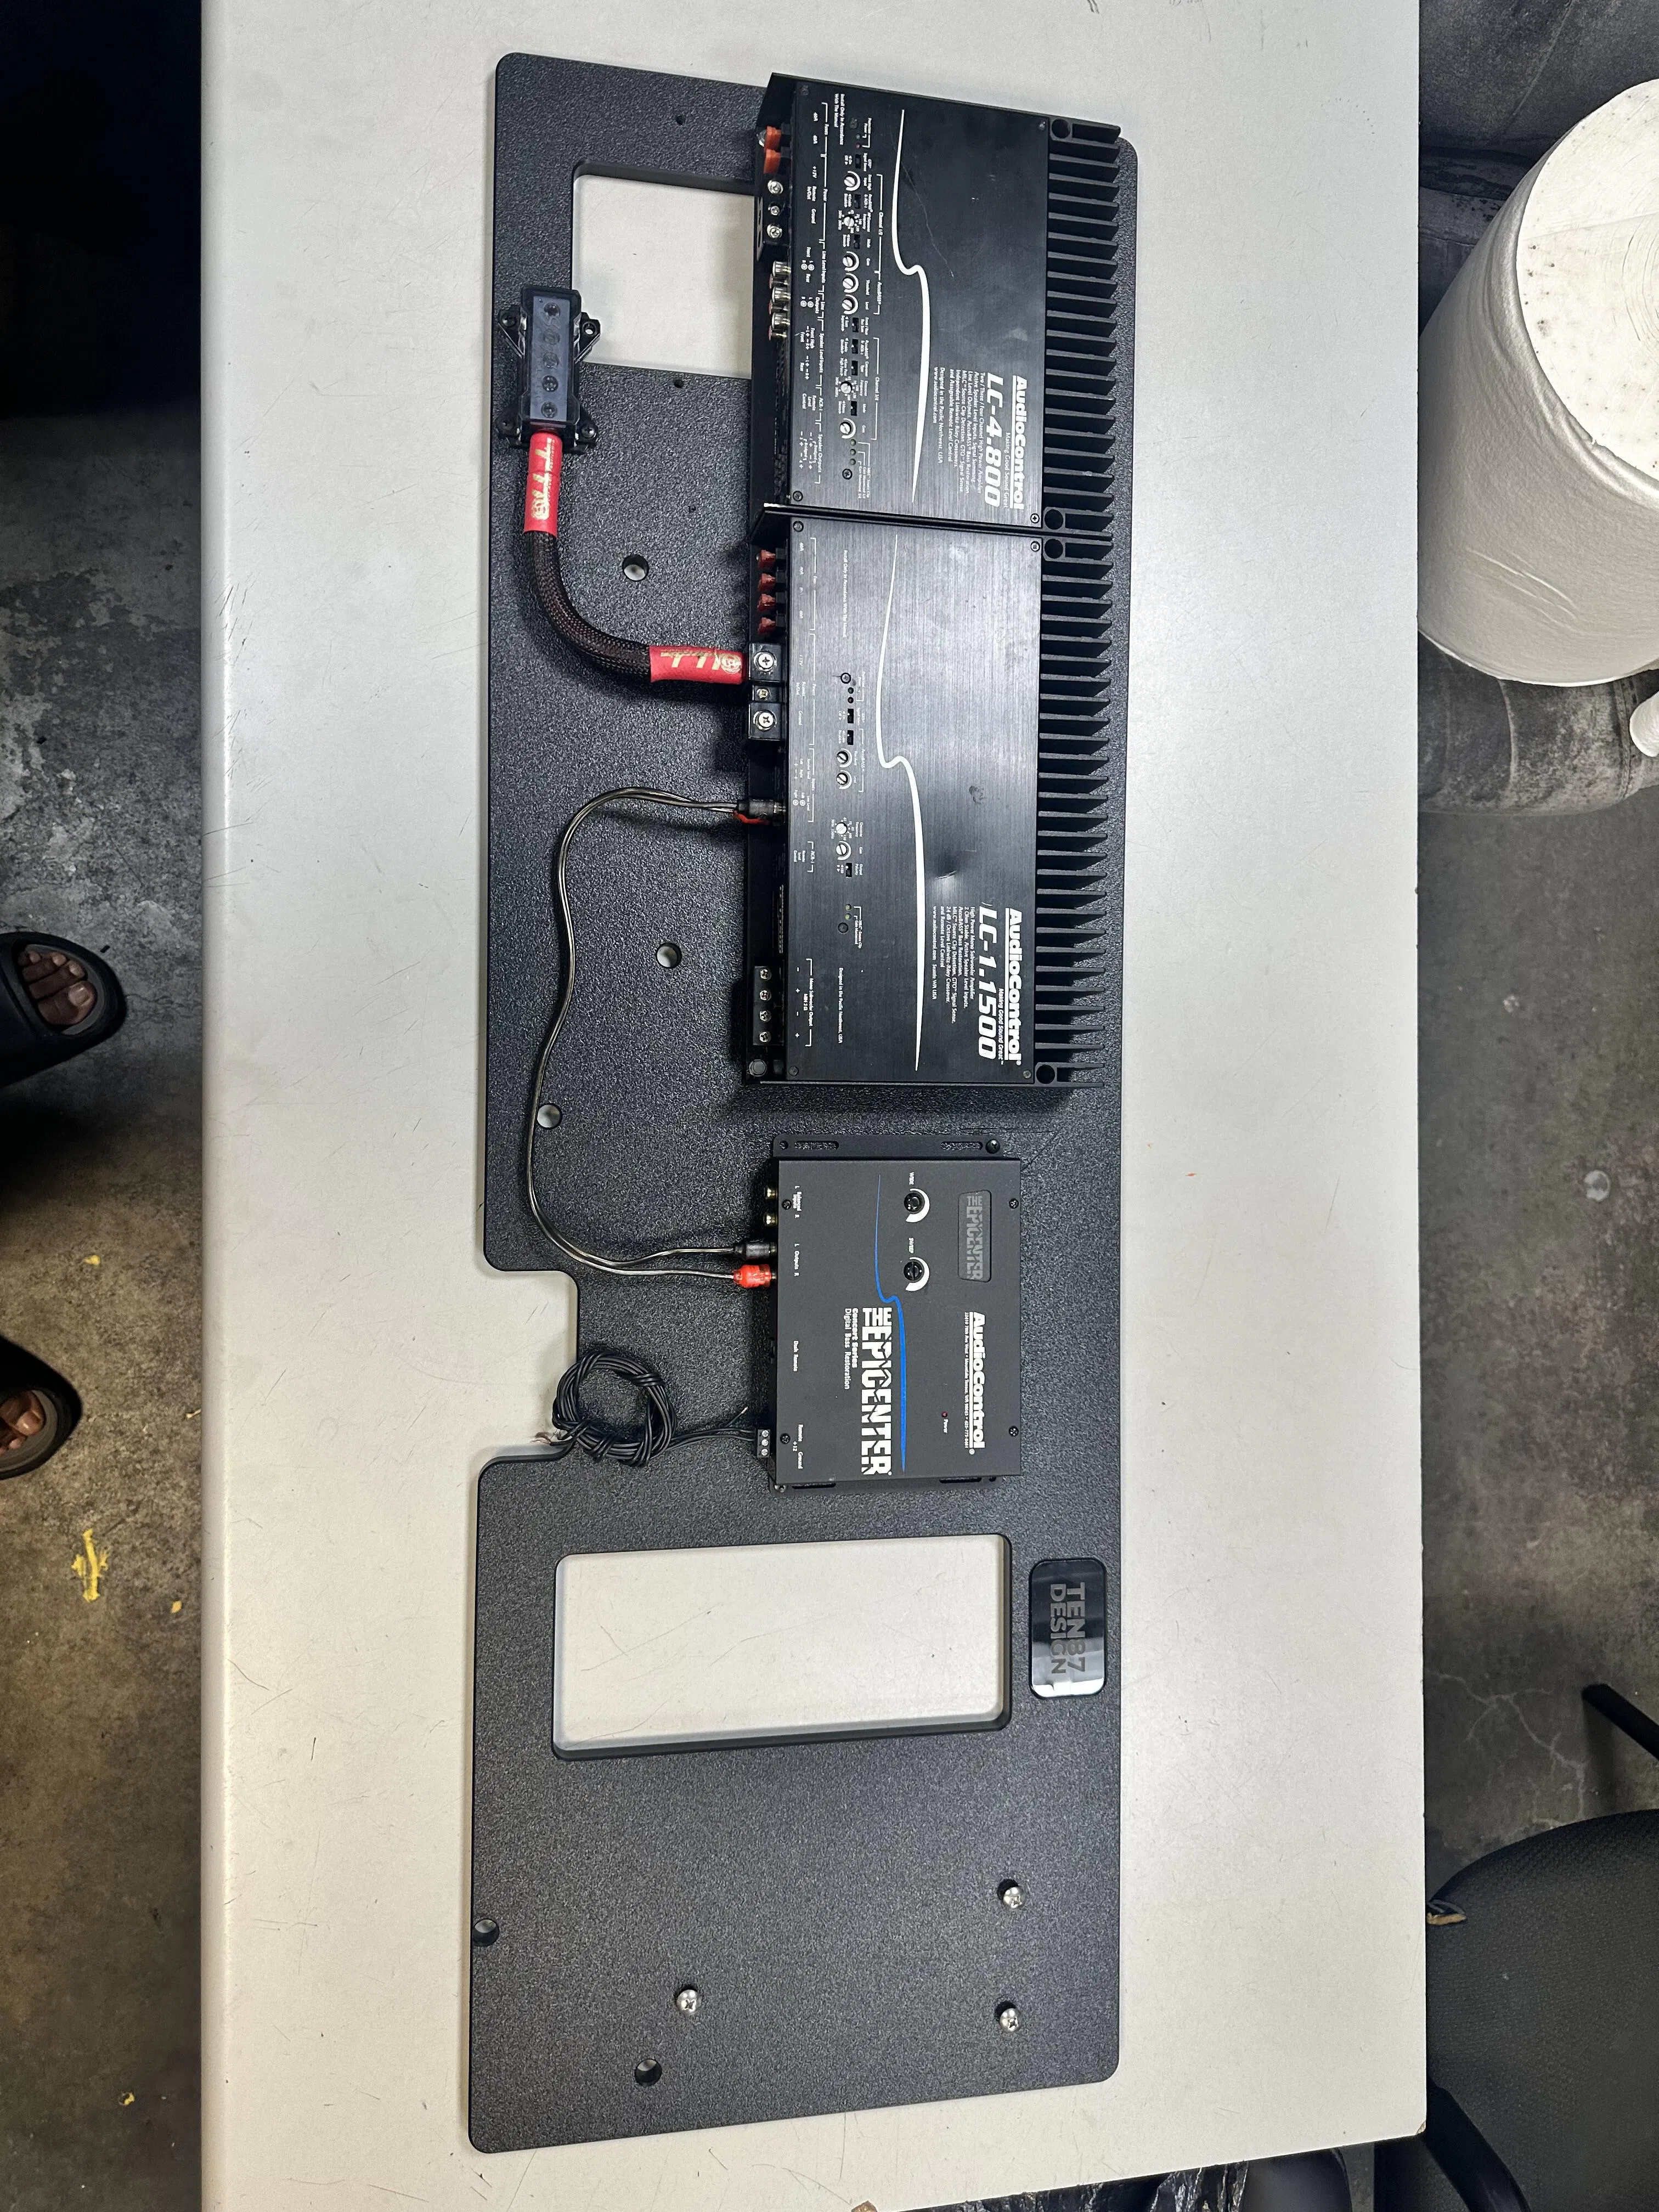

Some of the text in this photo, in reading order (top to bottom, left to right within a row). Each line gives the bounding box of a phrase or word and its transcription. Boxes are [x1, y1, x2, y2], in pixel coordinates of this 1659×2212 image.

[985, 373, 1003, 507] LC-4.800
[1013, 375, 1028, 510] AudioControl
[932, 980, 937, 988] WA
[979, 906, 997, 1059] LC-1.1500
[967, 1196, 983, 1280] THE EPICENTER
[861, 1307, 892, 1475] THE EPICENTER
[1050, 1583, 1066, 1674] DESIGN
[1066, 1582, 1085, 1672] TEN87
